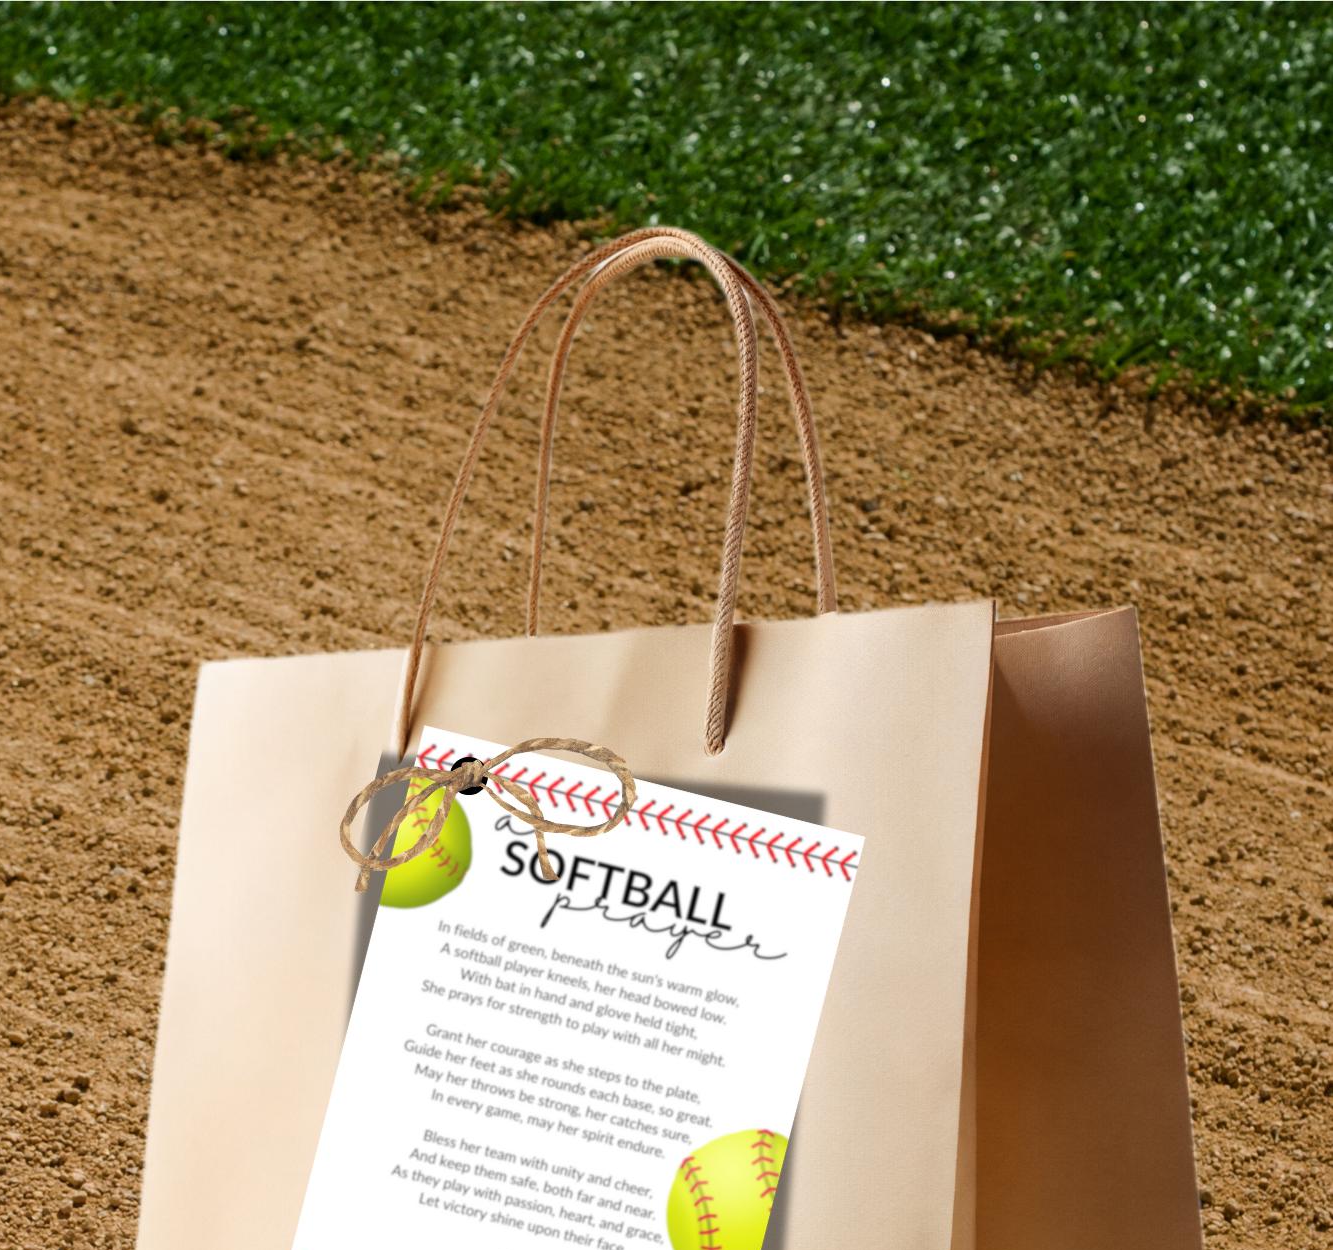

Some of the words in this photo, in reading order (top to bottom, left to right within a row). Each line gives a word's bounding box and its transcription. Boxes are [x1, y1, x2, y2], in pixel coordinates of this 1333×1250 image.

[494, 814, 536, 836] a
[499, 840, 733, 932] SOFTBALL
[437, 920, 451, 933] In
[453, 924, 488, 943] fields
[490, 936, 506, 946] of
[506, 941, 548, 960] green,
[550, 949, 604, 972] beneath
[606, 964, 629, 978] the
[631, 972, 663, 988] sun's
[666, 981, 703, 997] warm
[704, 990, 740, 1008] glow,
[539, 893, 788, 960] prayer
[439, 942, 451, 955] A
[453, 948, 502, 967] softball
[502, 960, 545, 978] player
[546, 969, 591, 992] kneels,
[593, 981, 616, 996] her
[618, 987, 652, 1006] head
[652, 996, 699, 1017] bowed
[699, 1007, 725, 1025] low.
[460, 968, 492, 986] With
[494, 977, 516, 993] bat
[518, 983, 531, 996] in
[533, 987, 568, 1006] hand
[568, 999, 595, 1013] and
[594, 1005, 631, 1022] glove
[633, 1012, 663, 1030] held
[664, 1021, 698, 1041] tight,
[421, 980, 446, 996] She
[447, 989, 483, 1006] prays
[486, 996, 506, 1011] for
[508, 1005, 563, 1025] strength
[564, 1017, 580, 1030] to
[581, 1023, 610, 1039] play
[612, 1031, 641, 1045] with
[642, 1038, 660, 1050] all
[660, 1041, 684, 1055] her
[685, 1049, 724, 1068] might.
[425, 1023, 463, 1044] Grant
[465, 1033, 488, 1049] her
[489, 1043, 542, 1064] courage
[543, 1056, 559, 1068] as
[561, 1059, 585, 1074] she
[587, 1067, 621, 1083] steps
[624, 1075, 639, 1088] to
[641, 1079, 664, 1094] the
[664, 1086, 701, 1105] plate,
[403, 1039, 442, 1059] Guide
[444, 1050, 467, 1064] her
[469, 1056, 496, 1073] feet
[497, 1066, 513, 1077] as
[515, 1069, 539, 1084] she
[540, 1077, 586, 1096] rounds
[588, 1089, 620, 1104] each
[621, 1094, 655, 1115] base,
[658, 1107, 674, 1118] so
[675, 1111, 712, 1129] great.
[414, 1063, 443, 1082] May
[445, 1071, 468, 1086] her
[470, 1079, 515, 1099] throws
[517, 1090, 536, 1104] be
[537, 1097, 582, 1119] strong,
[584, 1106, 607, 1122] her
[608, 1116, 658, 1135] catches
[661, 1129, 692, 1146] sure,
[430, 1089, 444, 1102] In
[445, 1096, 483, 1114] every
[484, 1105, 524, 1124] game,
[526, 1116, 555, 1131] may
[556, 1121, 579, 1136] her
[581, 1130, 615, 1146] spirit
[616, 1139, 664, 1159] endure.
[408, 1148, 438, 1165] And
[438, 1155, 471, 1174] keep
[473, 1165, 507, 1182] them
[510, 1176, 540, 1193] safe,
[542, 1181, 574, 1199] both
[575, 1190, 595, 1204] far
[596, 1198, 623, 1212] and
[623, 1205, 655, 1220] near.
[422, 1129, 456, 1149] Bless
[458, 1139, 481, 1153] her
[483, 1146, 517, 1163] team
[519, 1157, 549, 1172] with
[550, 1165, 585, 1182] unity
[586, 1174, 612, 1188] and
[613, 1180, 653, 1200] cheer,
[390, 1165, 408, 1179] As
[410, 1170, 441, 1188] they
[441, 1179, 471, 1196] play
[473, 1188, 502, 1202] with
[503, 1196, 556, 1218] passion,
[558, 1206, 596, 1229] heart,
[598, 1220, 625, 1233] and
[624, 1227, 664, 1245] grace,
[418, 1192, 440, 1209] Let
[442, 1202, 488, 1221] victory
[490, 1212, 525, 1229] shine
[526, 1223, 561, 1238] upon
[562, 1230, 594, 1246] their
